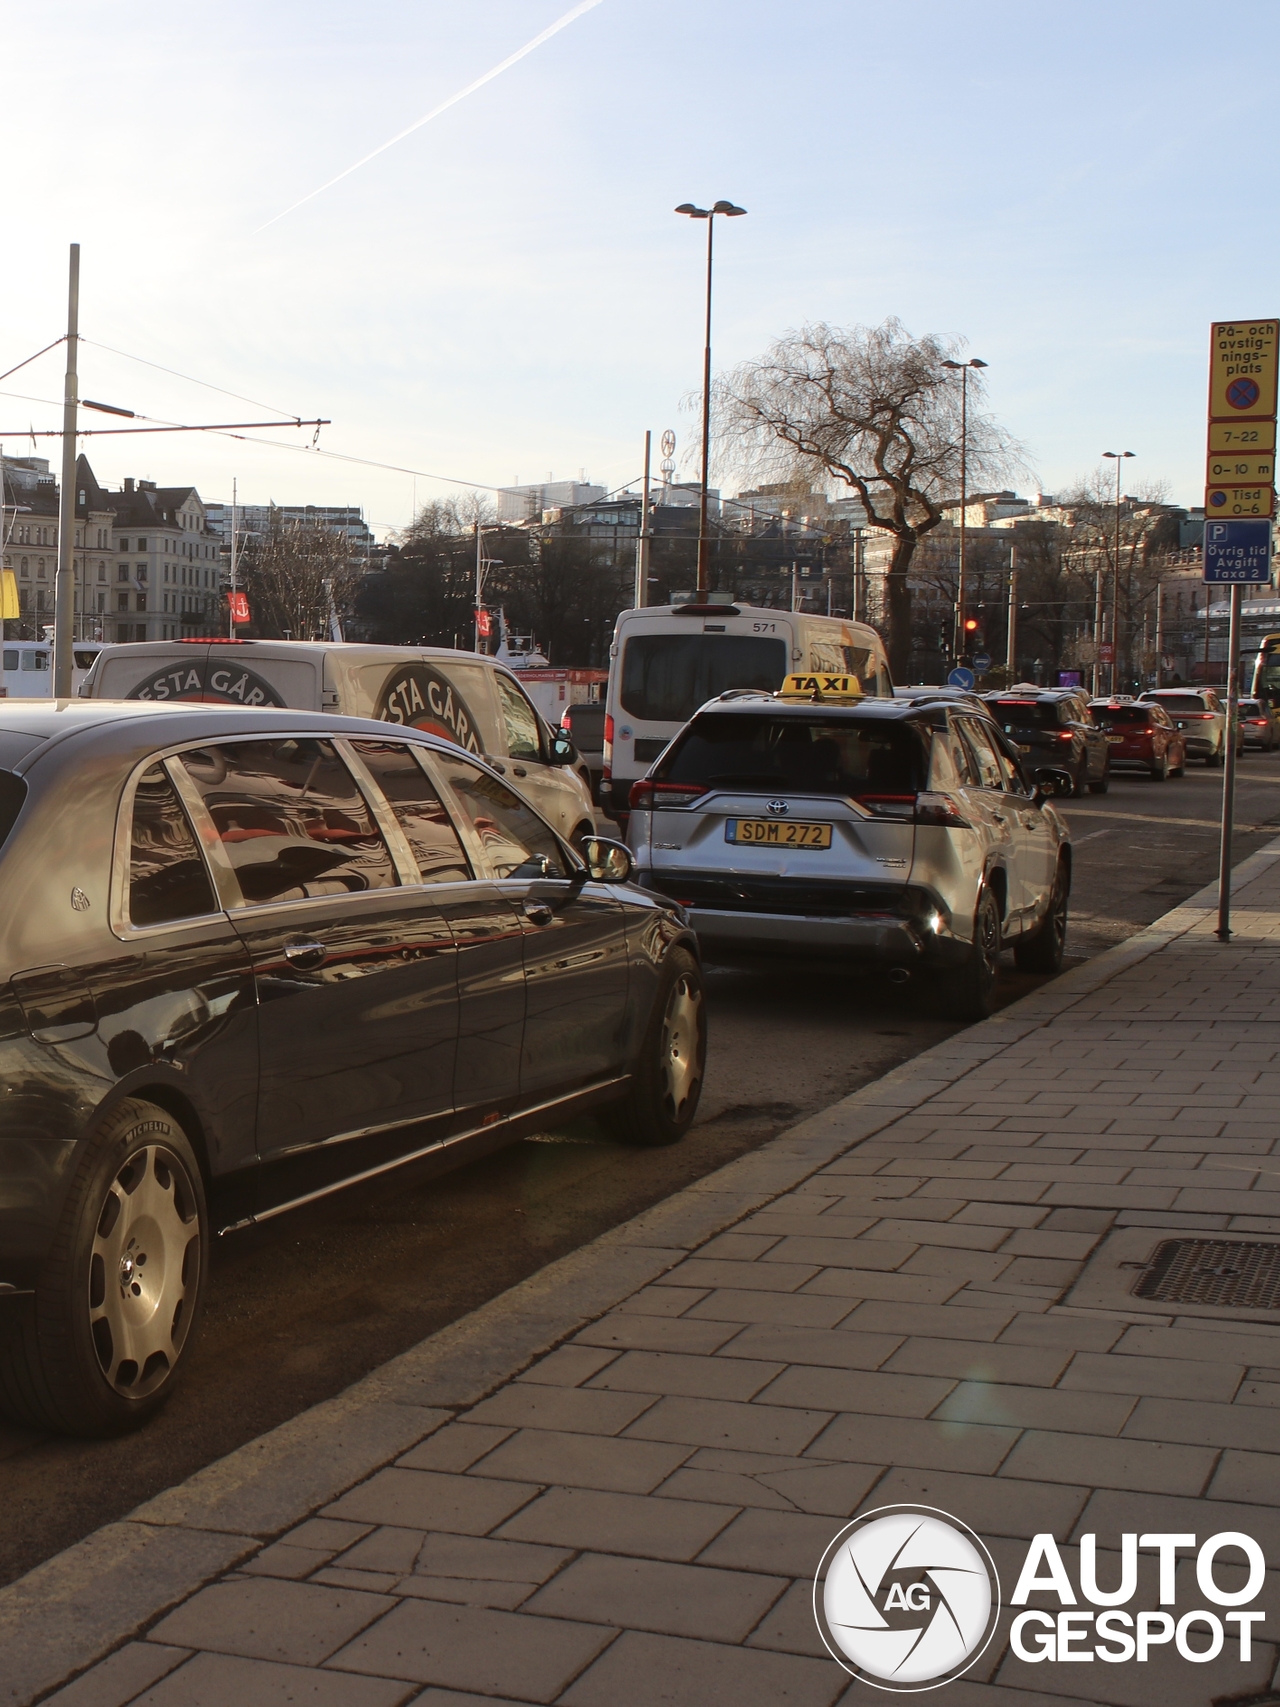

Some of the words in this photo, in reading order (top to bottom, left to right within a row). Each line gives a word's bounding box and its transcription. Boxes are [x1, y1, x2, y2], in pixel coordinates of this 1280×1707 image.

[1218, 326, 1243, 337] På-
[1249, 324, 1273, 335] och
[1219, 337, 1272, 350] avstig-
[1222, 351, 1268, 363] nings-
[1226, 363, 1262, 377] plats
[1224, 431, 1258, 442] 7-22
[1258, 465, 1270, 474] m
[1232, 489, 1261, 500] Tisd
[1232, 503, 1260, 514] 0-6
[1213, 525, 1224, 540] P
[1208, 545, 1244, 557] Övrig
[1249, 546, 1267, 555] tid
[1216, 557, 1257, 569] Avgift
[1214, 569, 1246, 578] Taxa
[1251, 569, 1259, 578] 2
[752, 623, 776, 633] 571
[791, 676, 849, 690] TAXI
[210, 673, 275, 707] GÅR
[742, 823, 779, 841] SDM
[786, 825, 823, 844] 272
[125, 1121, 169, 1145] MICHELIN
